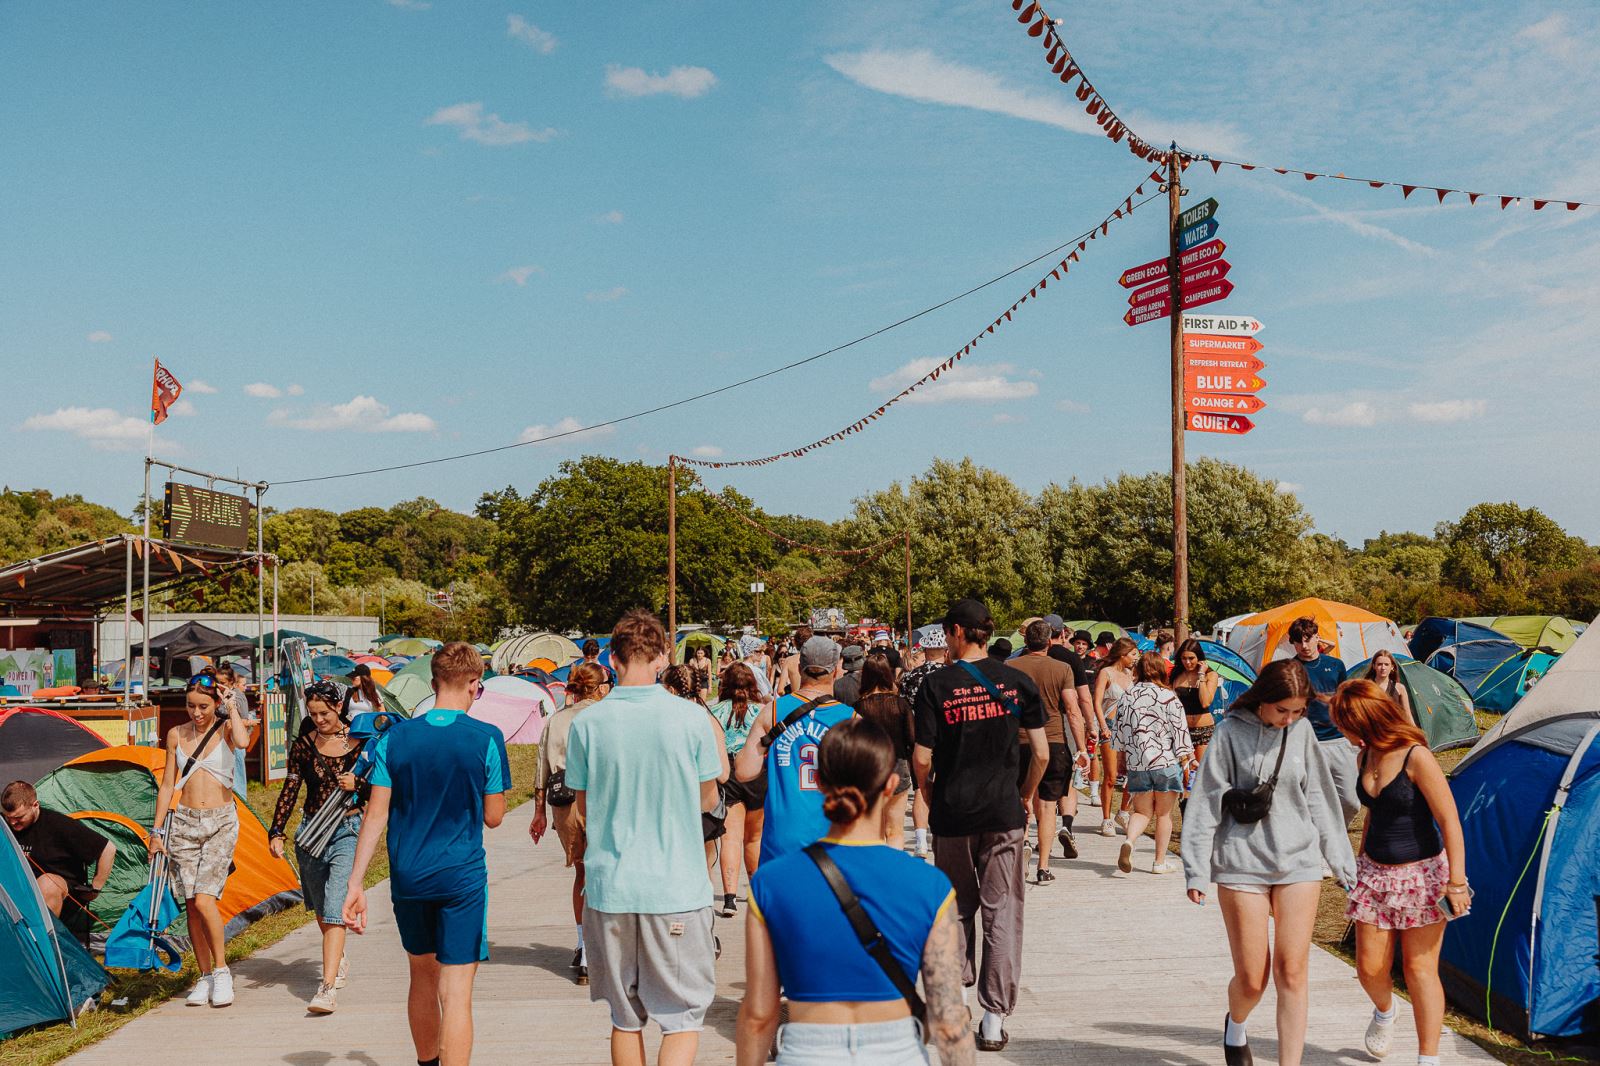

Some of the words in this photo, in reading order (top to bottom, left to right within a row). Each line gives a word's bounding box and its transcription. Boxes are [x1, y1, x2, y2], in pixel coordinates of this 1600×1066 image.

[1182, 203, 1209, 227] TOILETS
[1184, 224, 1208, 245] WATER
[1181, 252, 1198, 265] WHITE
[1199, 247, 1211, 259] ECO
[1126, 269, 1145, 283] GREEN
[1146, 265, 1160, 277] ECO
[1184, 274, 1195, 284] PINK
[1195, 269, 1211, 280] MOON
[1137, 288, 1155, 301] SHUTTLE
[1155, 284, 1169, 296] BUSES
[1184, 286, 1221, 303] CAMPERVANS
[1131, 305, 1148, 316] GREEN
[1147, 300, 1166, 311] ARENA
[1135, 309, 1161, 323] ENTRANCE
[1184, 318, 1214, 329] FIRST
[1217, 320, 1238, 330] AID
[1189, 339, 1246, 350] SUPERMARKET
[1189, 359, 1218, 367] REFRESH
[1220, 360, 1248, 368] RETREAT
[1196, 375, 1232, 390] BLUE
[1191, 397, 1234, 408] ORANGE
[1191, 414, 1230, 430] QUIET
[8, 671, 28, 681] POWER
[269, 703, 285, 721] AIR
[270, 728, 286, 746] HUB
